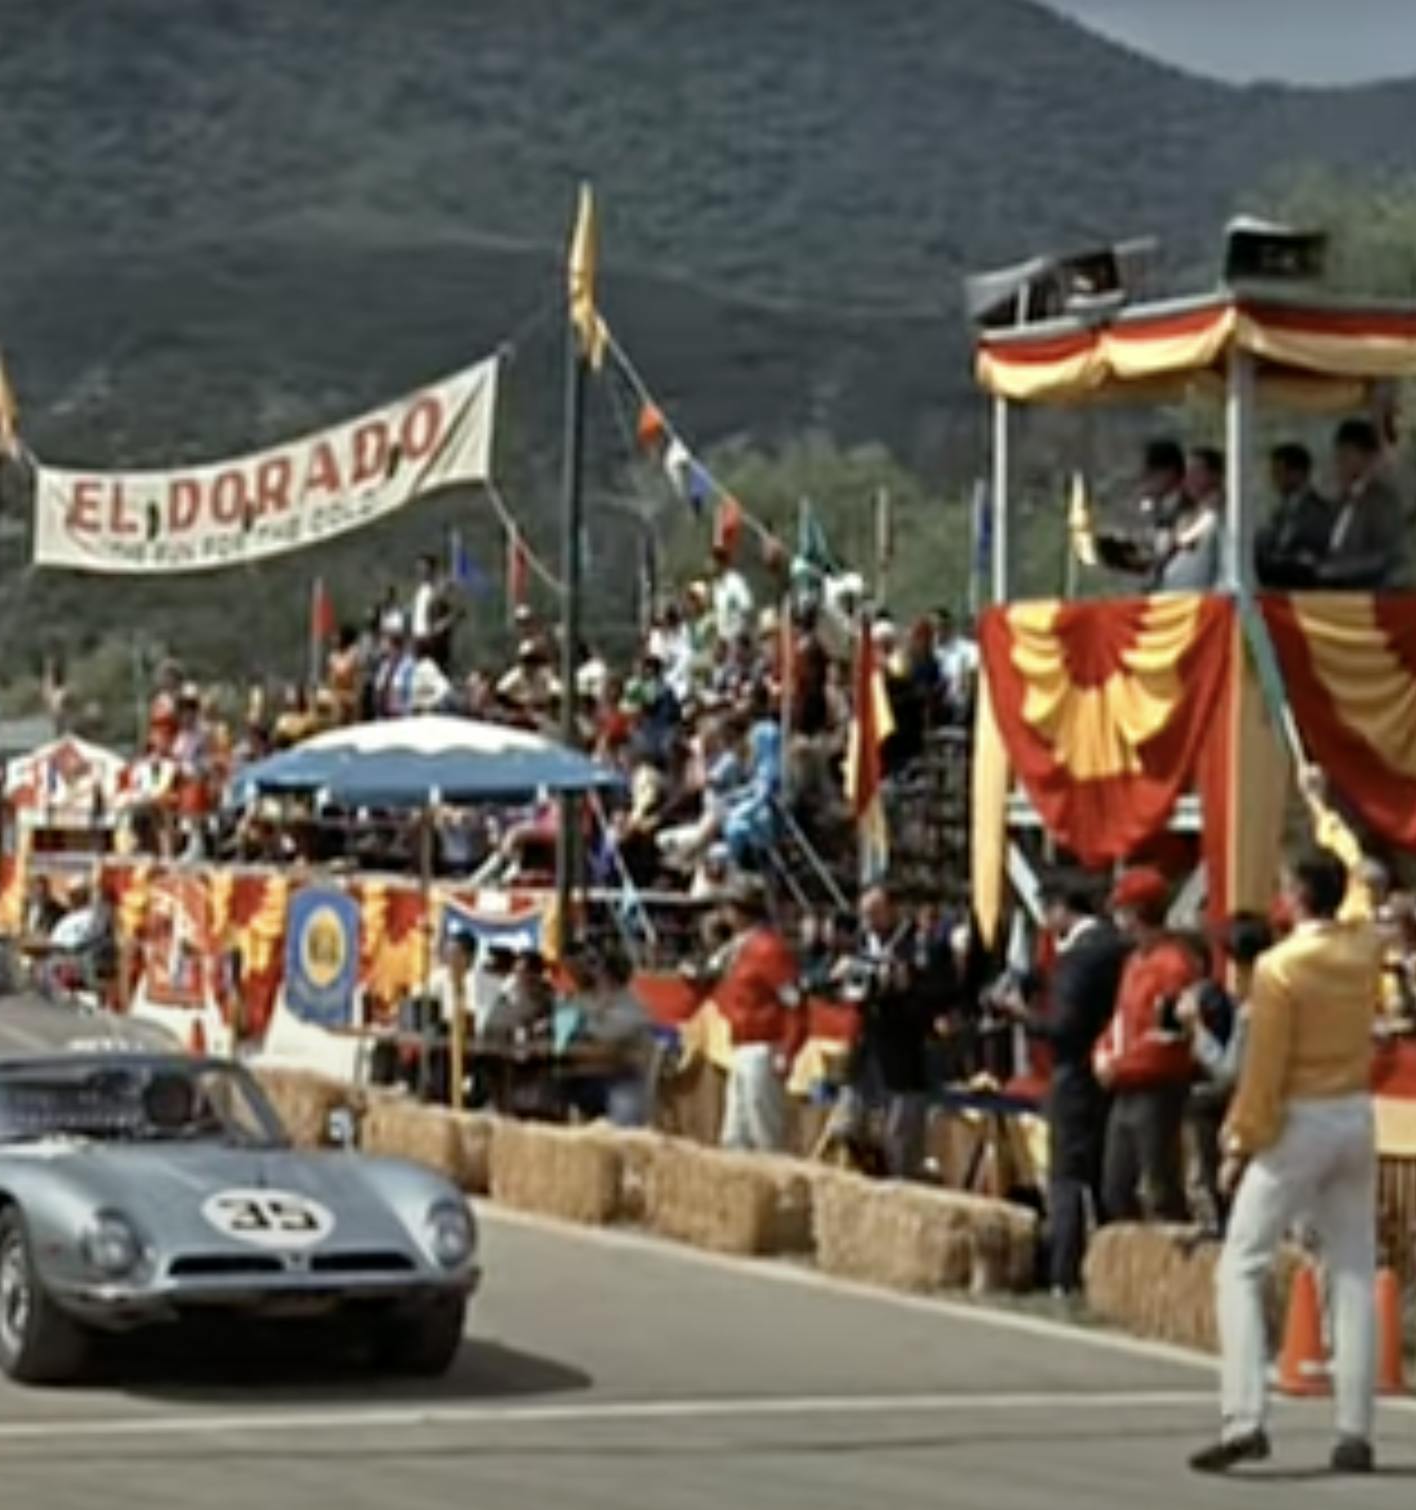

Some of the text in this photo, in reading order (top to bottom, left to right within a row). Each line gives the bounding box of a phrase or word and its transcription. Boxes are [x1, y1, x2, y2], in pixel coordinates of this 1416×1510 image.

[71, 399, 443, 534] EL DORADO
[216, 1200, 320, 1231] 35
